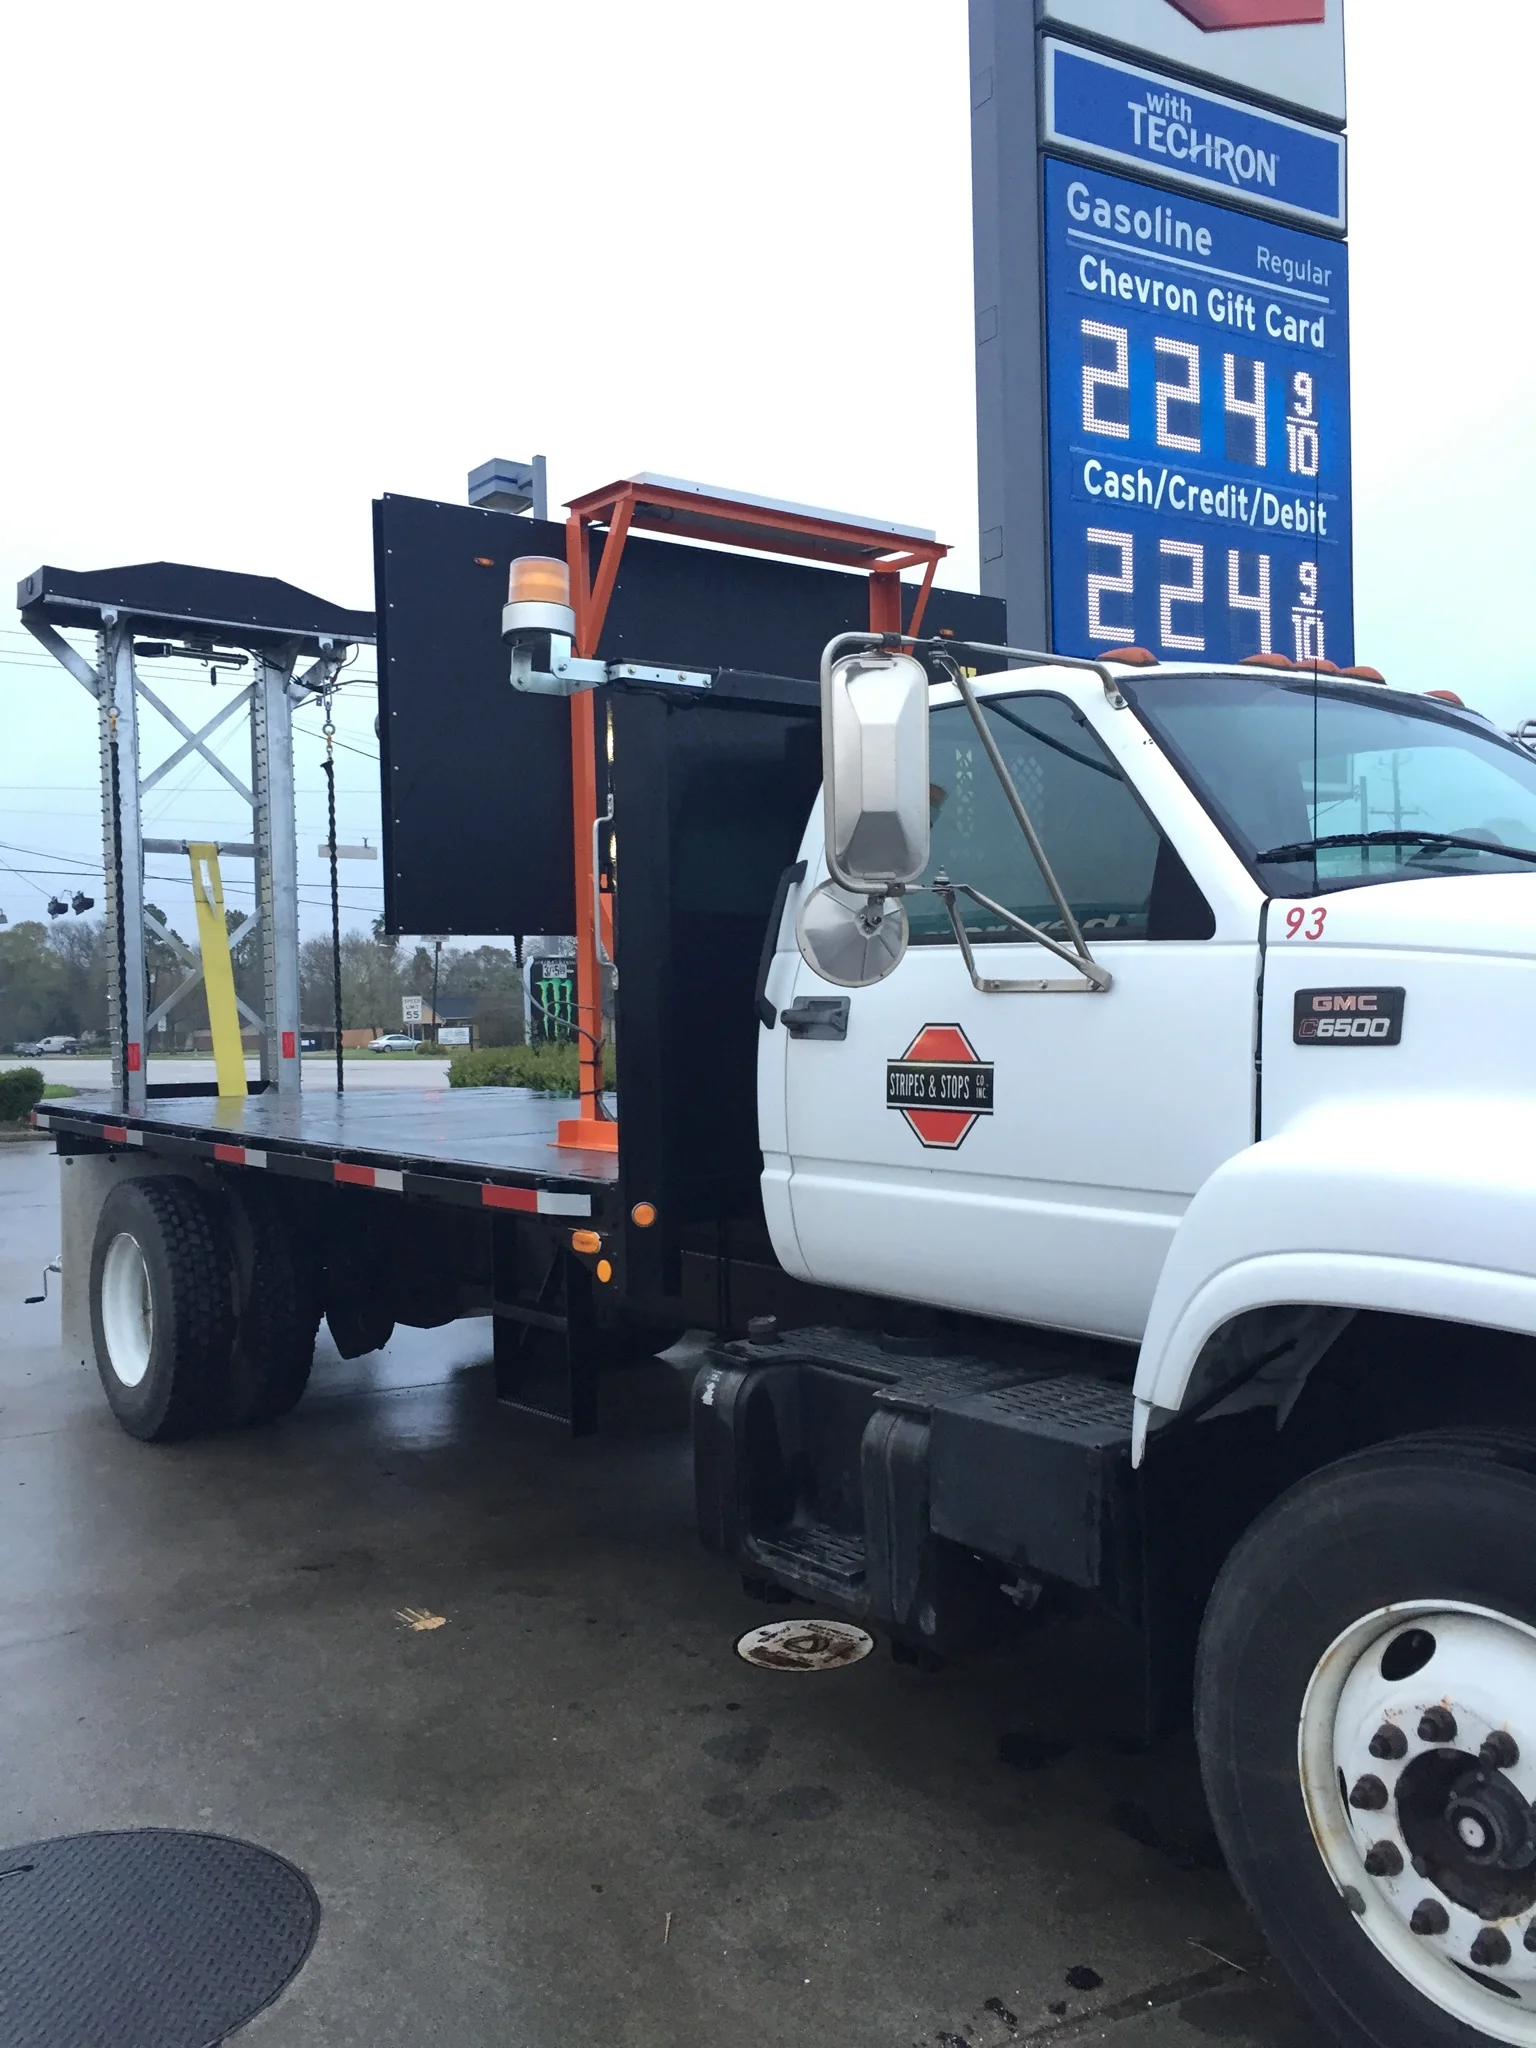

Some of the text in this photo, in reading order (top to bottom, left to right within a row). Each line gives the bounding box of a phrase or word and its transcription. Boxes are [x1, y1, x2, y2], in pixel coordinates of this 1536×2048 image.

[1146, 91, 1192, 124] with
[1127, 101, 1277, 186] TECHRON
[1066, 181, 1213, 256] Gasoline
[1256, 245, 1332, 287] Regular
[1079, 255, 1325, 348] Chevron Gift Card
[1083, 459, 1328, 536] Cash/Credit/Debit
[1286, 907, 1327, 940] 93
[406, 1011, 419, 1019] 55
[1312, 995, 1378, 1011] GMC
[1299, 1018, 1390, 1037] C6500
[890, 1073, 970, 1100] STRIPES & STOPS
